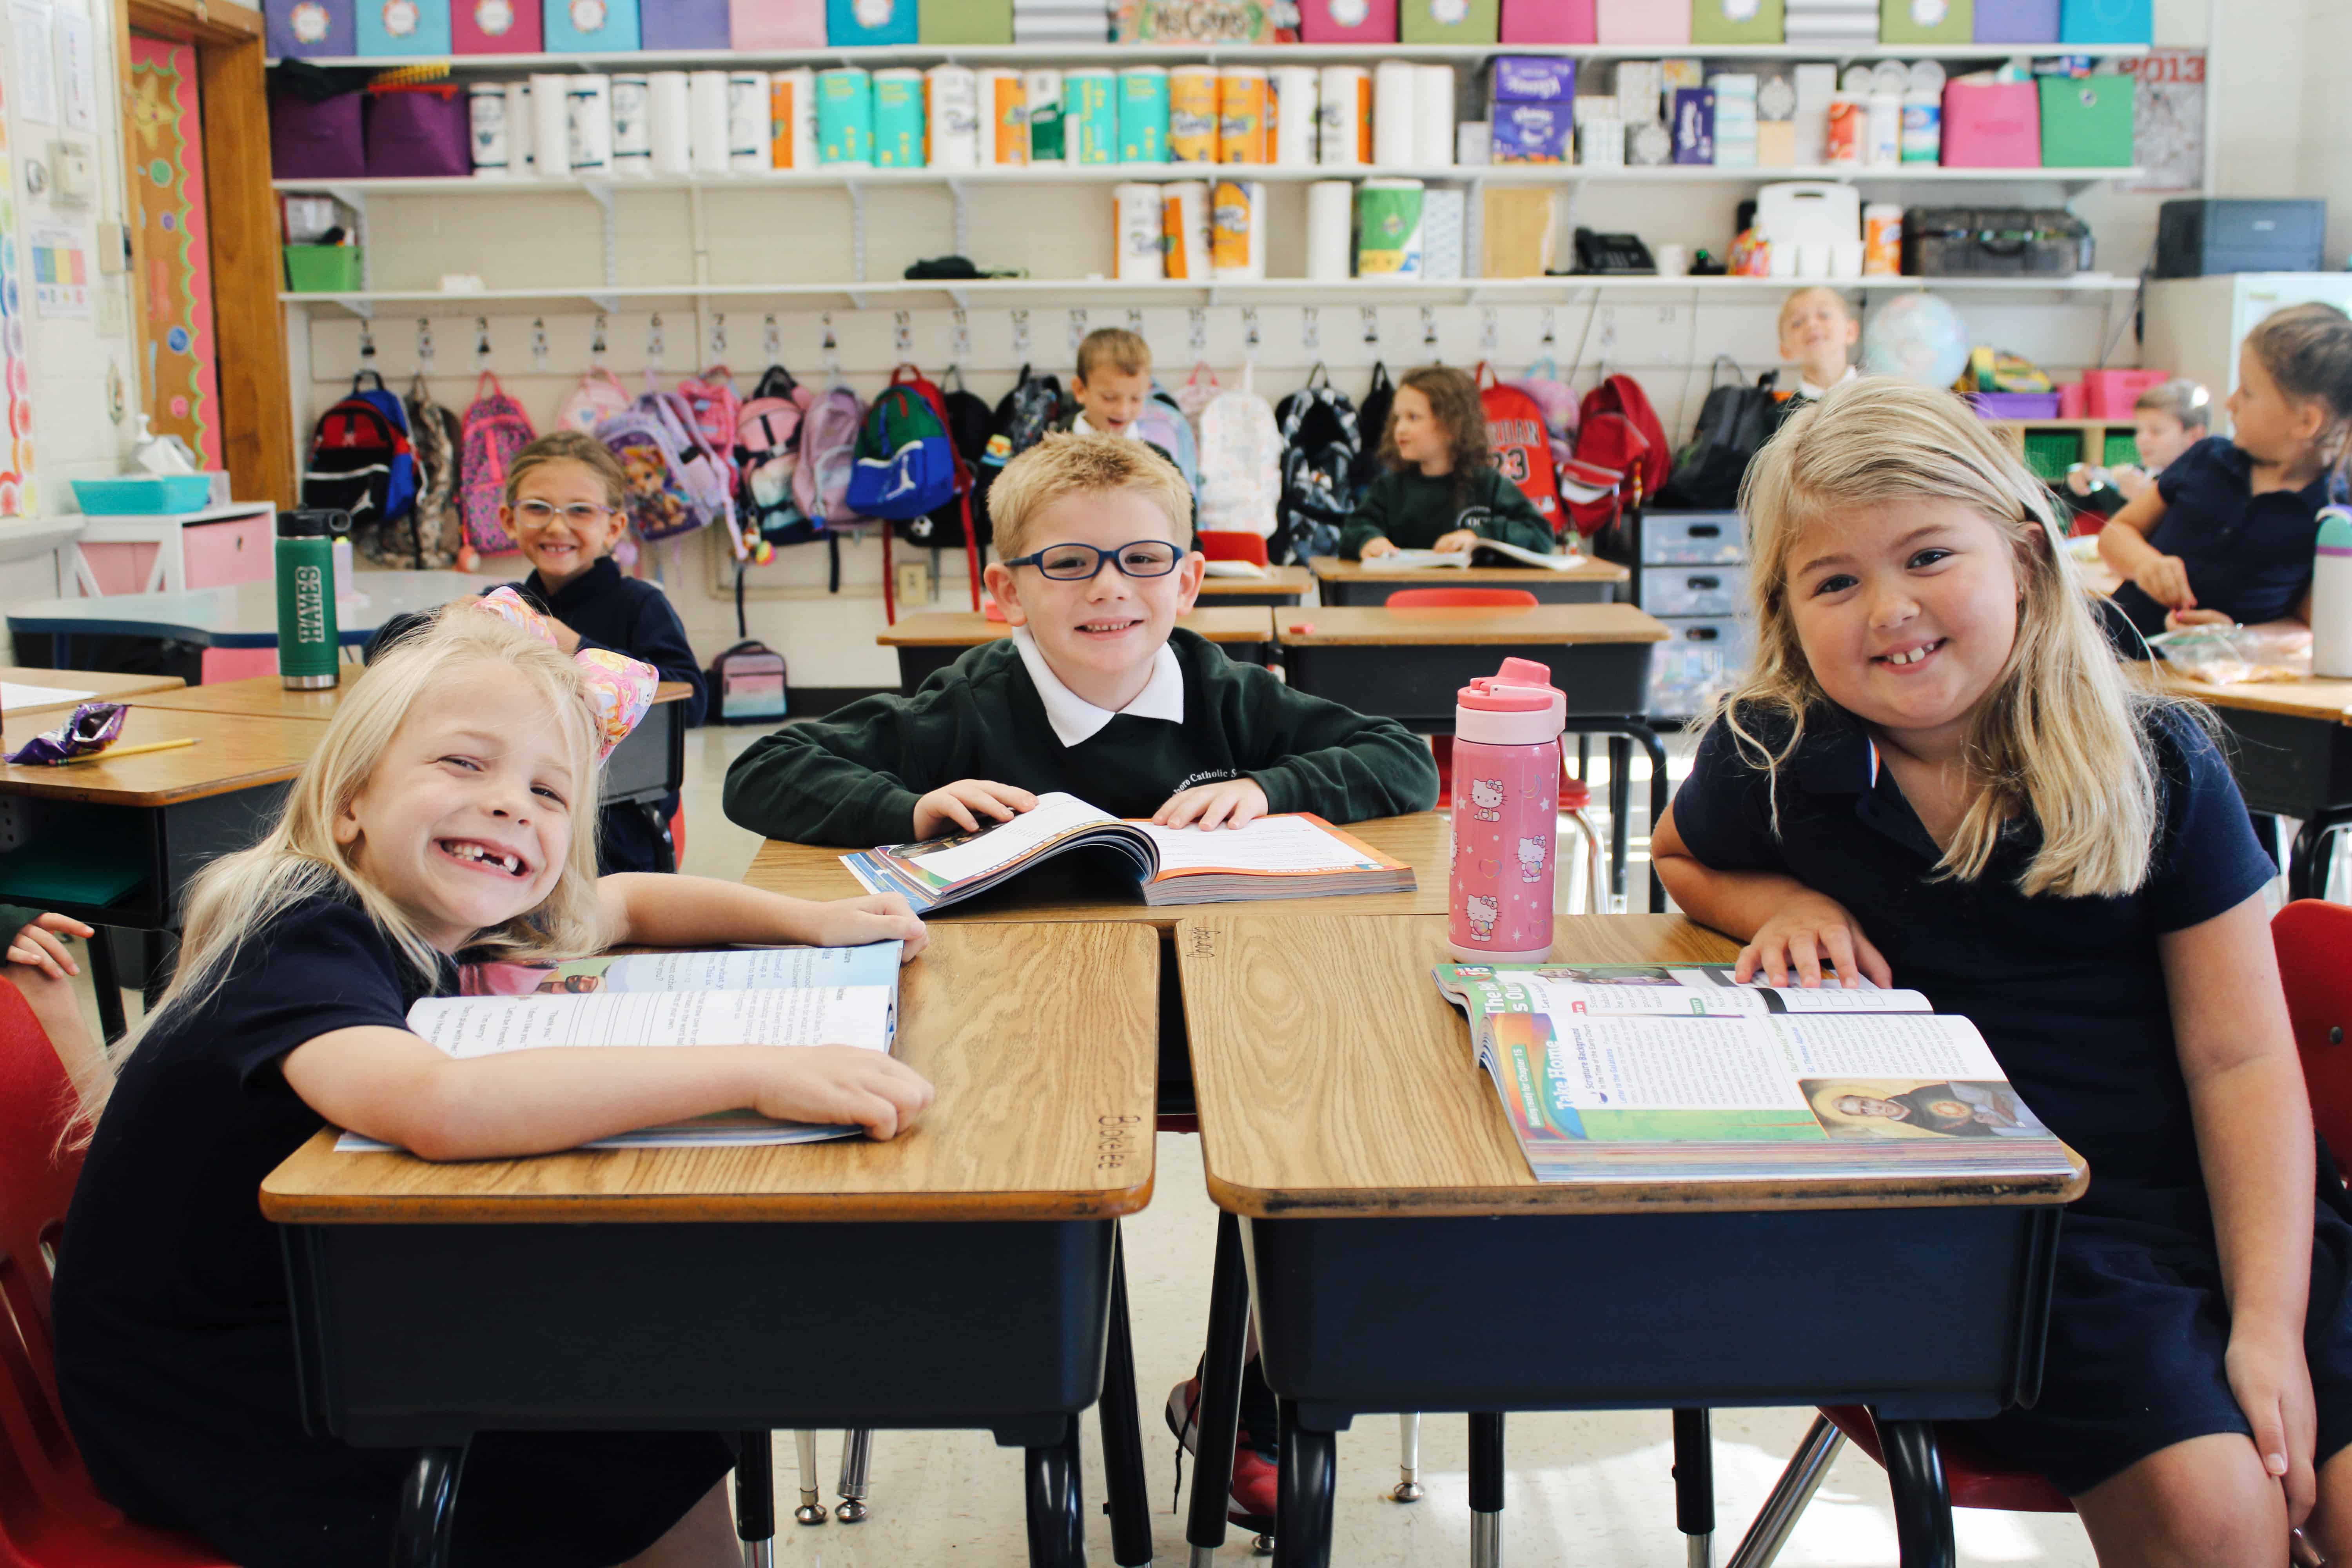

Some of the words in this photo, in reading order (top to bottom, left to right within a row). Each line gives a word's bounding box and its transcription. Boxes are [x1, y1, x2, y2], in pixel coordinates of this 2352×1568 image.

[296, 566, 325, 643] HAYES
[1189, 769, 1228, 782] Catholic
[1570, 1028, 1588, 1060] Background
[1778, 1038, 1796, 1060] Catholic
[1797, 1045, 1813, 1064] Thomas
[1517, 1058, 1530, 1082] Chapter
[1546, 1041, 1564, 1078] Home
[1521, 1083, 1530, 1092] for
[1579, 1062, 1595, 1089] Scripture
[1555, 1081, 1573, 1109] Take
